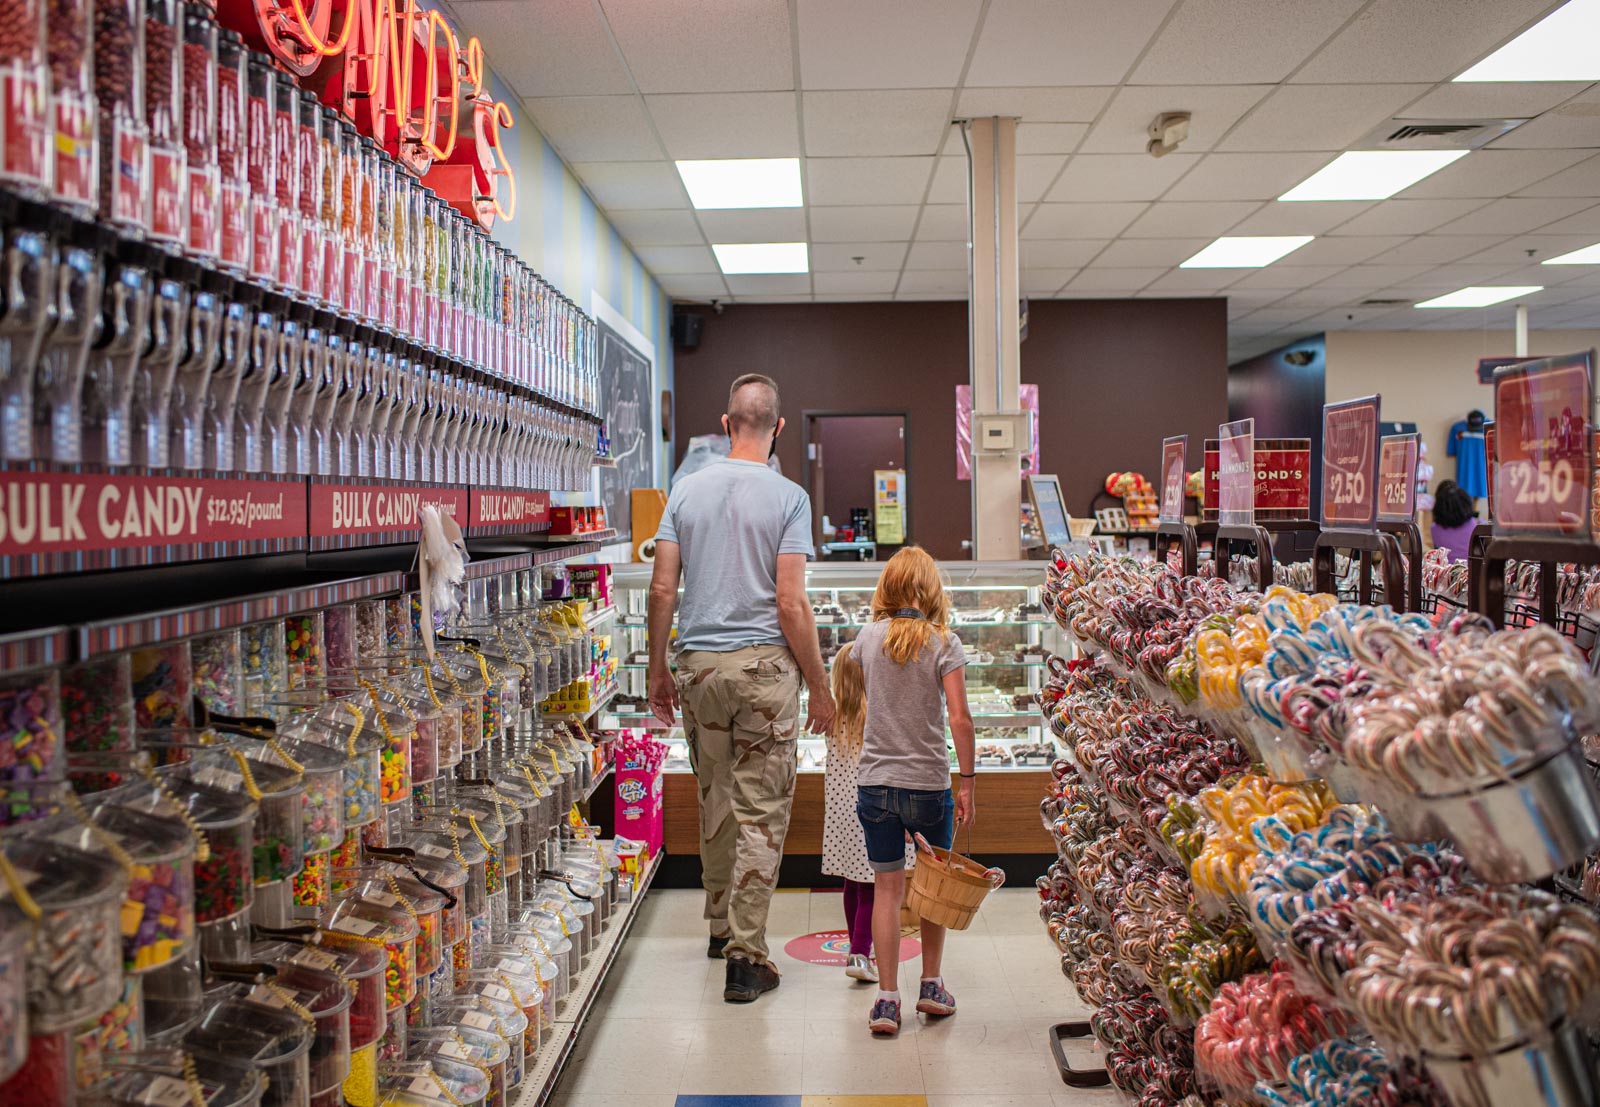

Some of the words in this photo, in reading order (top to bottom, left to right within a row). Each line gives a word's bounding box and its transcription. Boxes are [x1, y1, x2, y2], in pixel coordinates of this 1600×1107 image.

[1211, 470, 1302, 480] HOND'S
[1330, 472, 1366, 504] $2.50
[1510, 458, 1573, 504] $2.50
[480, 495, 500, 522] BULK
[502, 495, 525, 520] CANDY
[1384, 482, 1407, 505] $2.95
[97, 484, 203, 540] CANDY
[207, 492, 283, 528] $12.95/pound
[332, 491, 372, 529] BULK
[376, 492, 420, 526] CANDY
